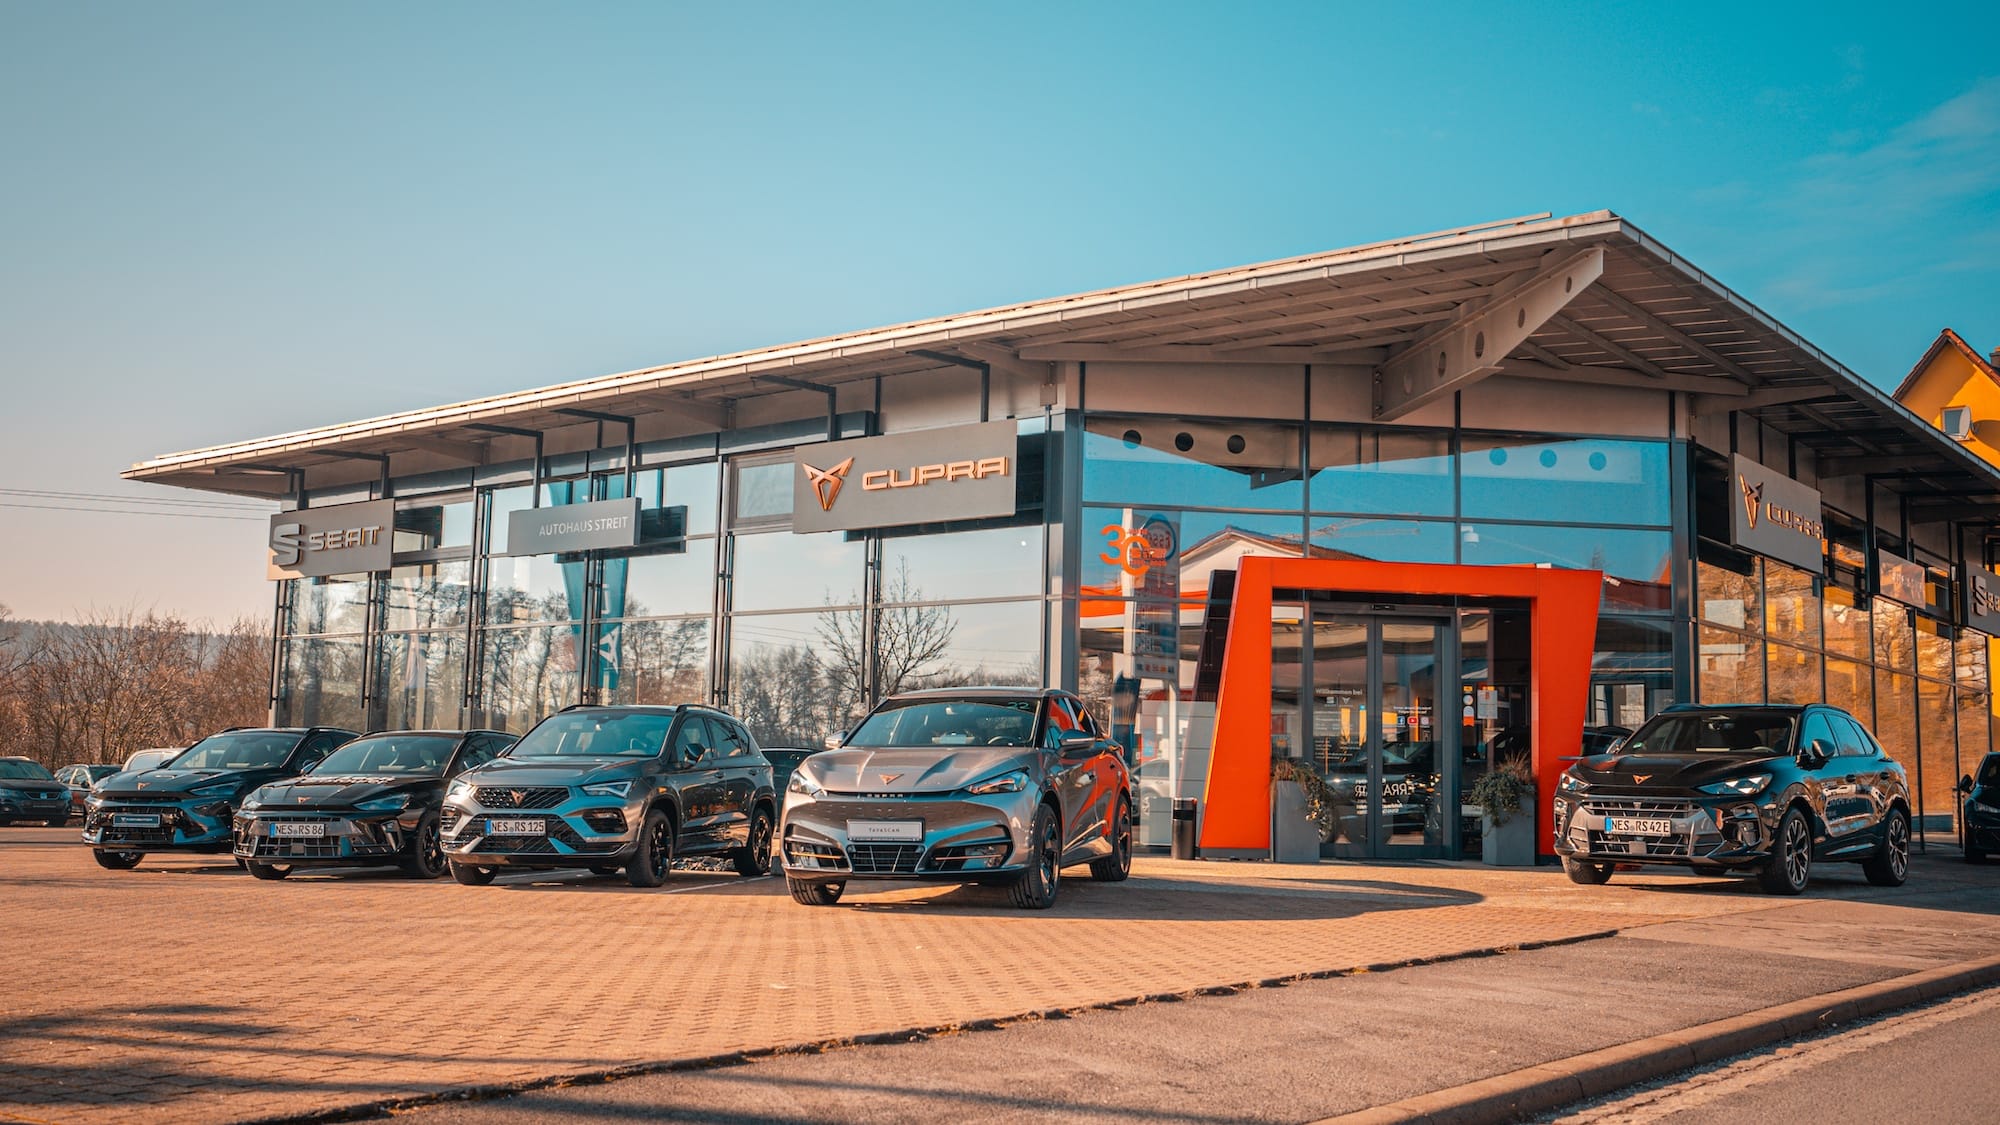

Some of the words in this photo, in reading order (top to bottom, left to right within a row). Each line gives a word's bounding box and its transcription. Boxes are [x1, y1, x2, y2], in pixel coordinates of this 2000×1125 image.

[862, 456, 1009, 490] CUPRA
[538, 519, 593, 537] AUTOHAUS
[594, 516, 629, 532] STREIT
[308, 525, 384, 552] SEAT
[275, 825, 293, 835] NES
[298, 825, 311, 835] RS
[312, 825, 323, 835] 86
[492, 821, 508, 832] NES
[514, 821, 526, 832] RS
[528, 821, 545, 832] 125
[1611, 819, 1630, 831] NES
[1635, 820, 1648, 832] RS
